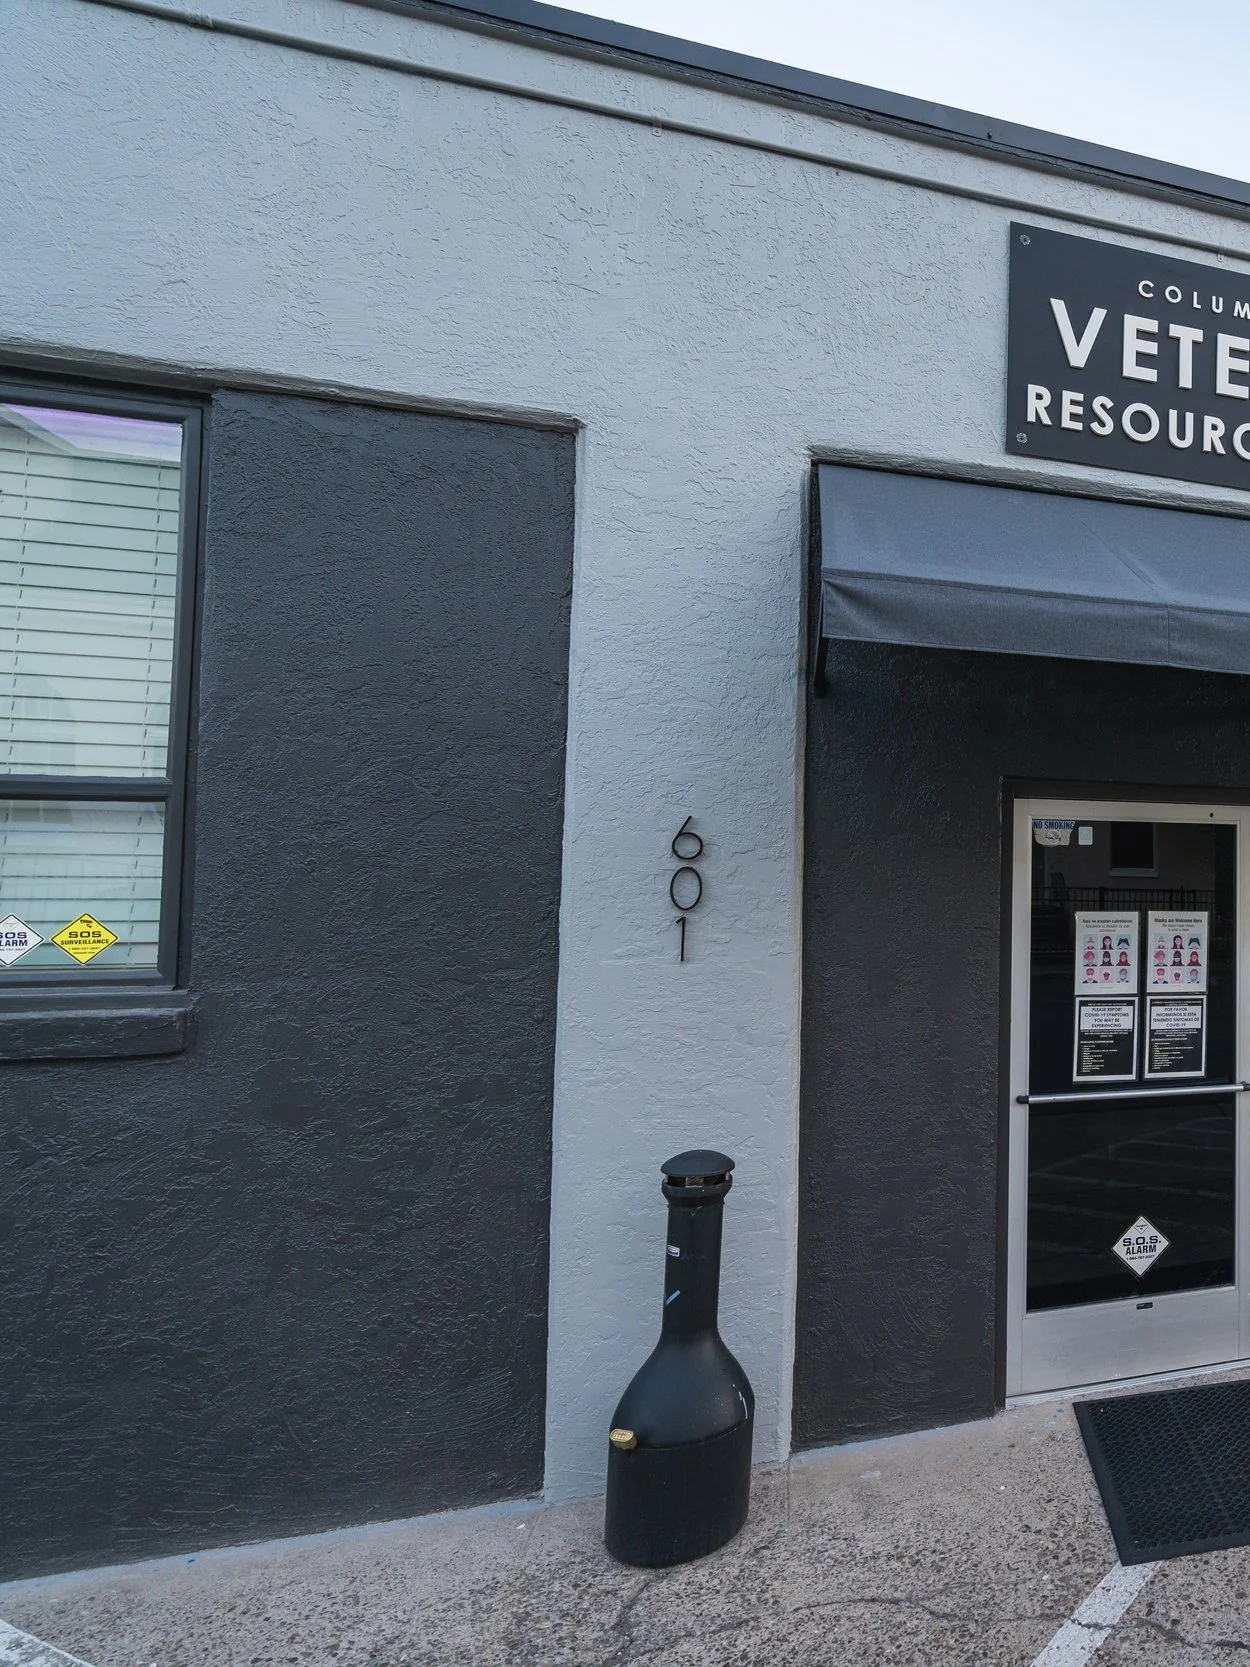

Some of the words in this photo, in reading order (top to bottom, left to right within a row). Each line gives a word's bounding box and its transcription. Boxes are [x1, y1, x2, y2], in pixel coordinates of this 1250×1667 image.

[1033, 820, 1043, 829] NO
[68, 930, 102, 939] SOS
[1123, 1236, 1161, 1247] S.O.S.
[1125, 1245, 1157, 1255] ALARM
